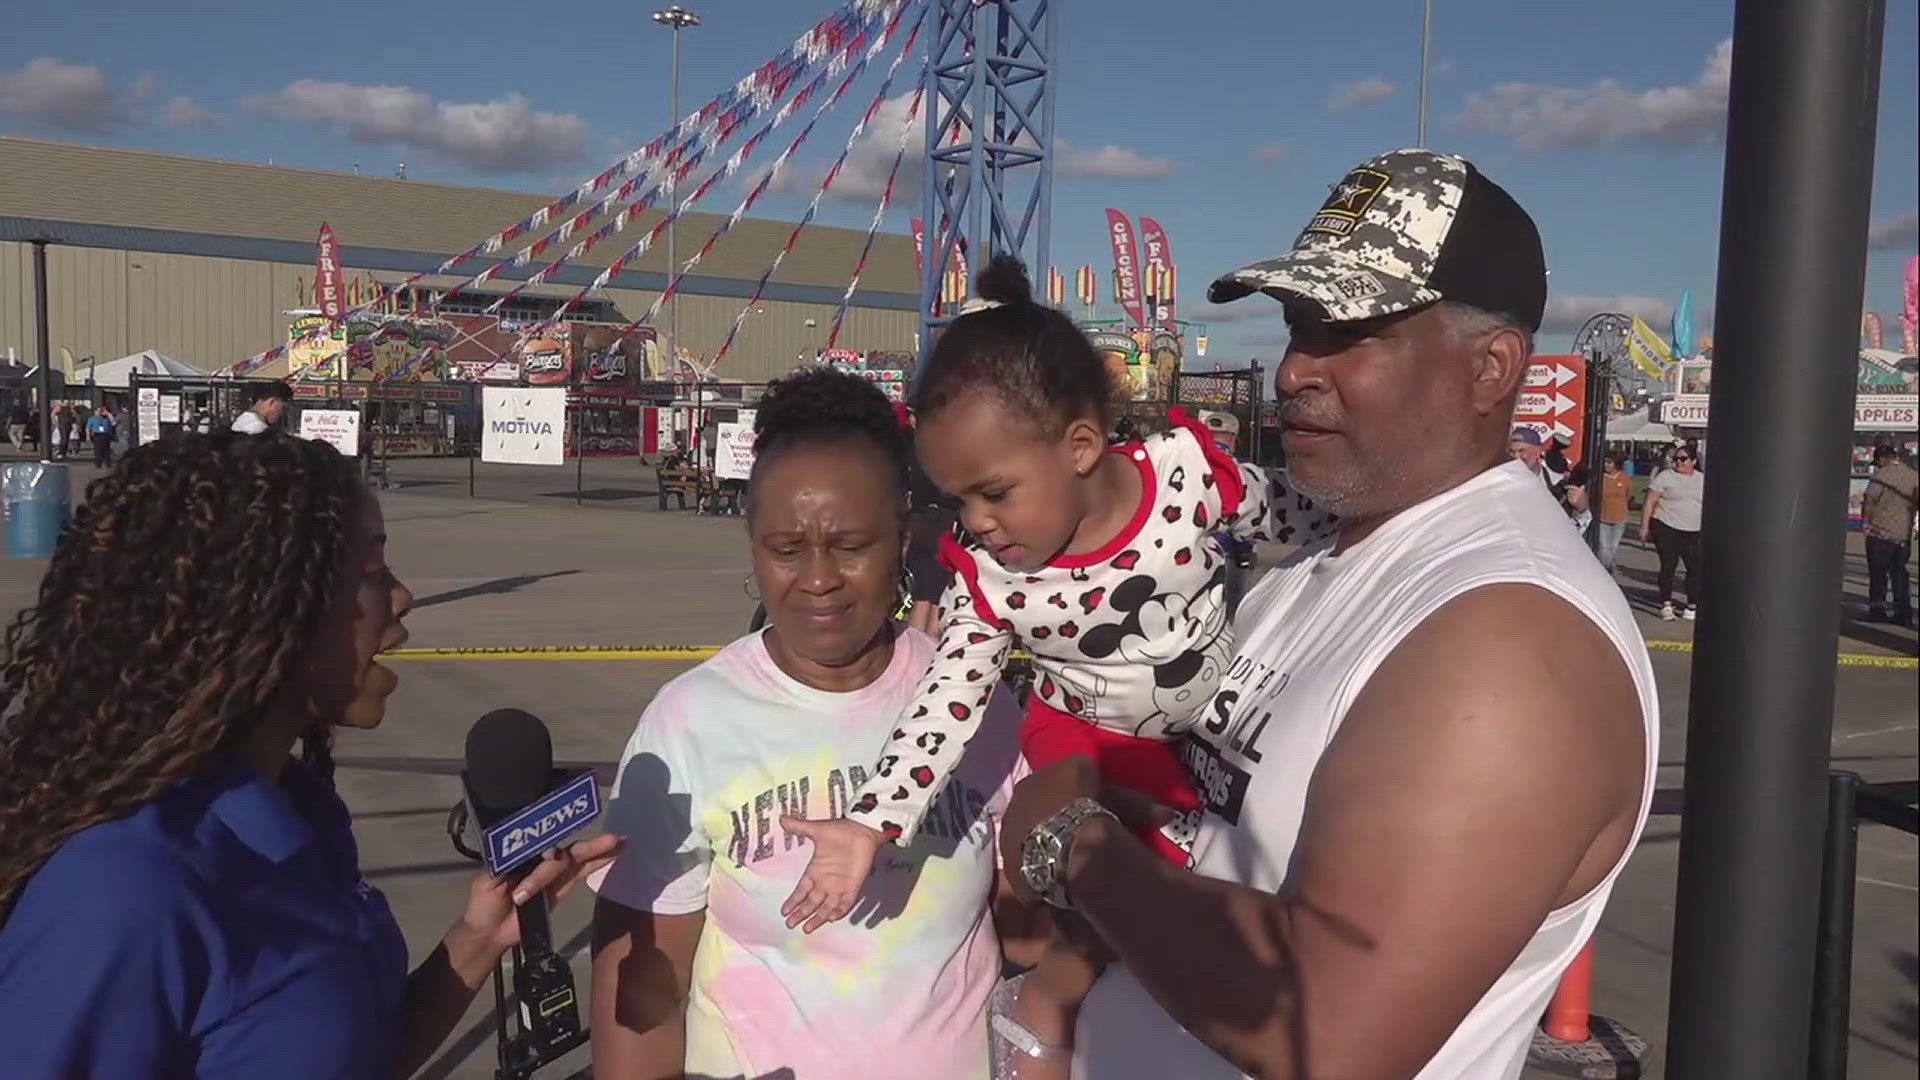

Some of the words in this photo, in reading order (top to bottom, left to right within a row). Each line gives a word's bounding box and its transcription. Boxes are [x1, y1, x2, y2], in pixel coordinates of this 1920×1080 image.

[321, 243, 338, 316] FRIES
[1113, 222, 1136, 299] CHICKEN
[491, 419, 552, 435] MOTIVA
[1671, 406, 1709, 418] COTTO
[1855, 409, 1914, 423] APPLES
[728, 775, 810, 868] NEW
